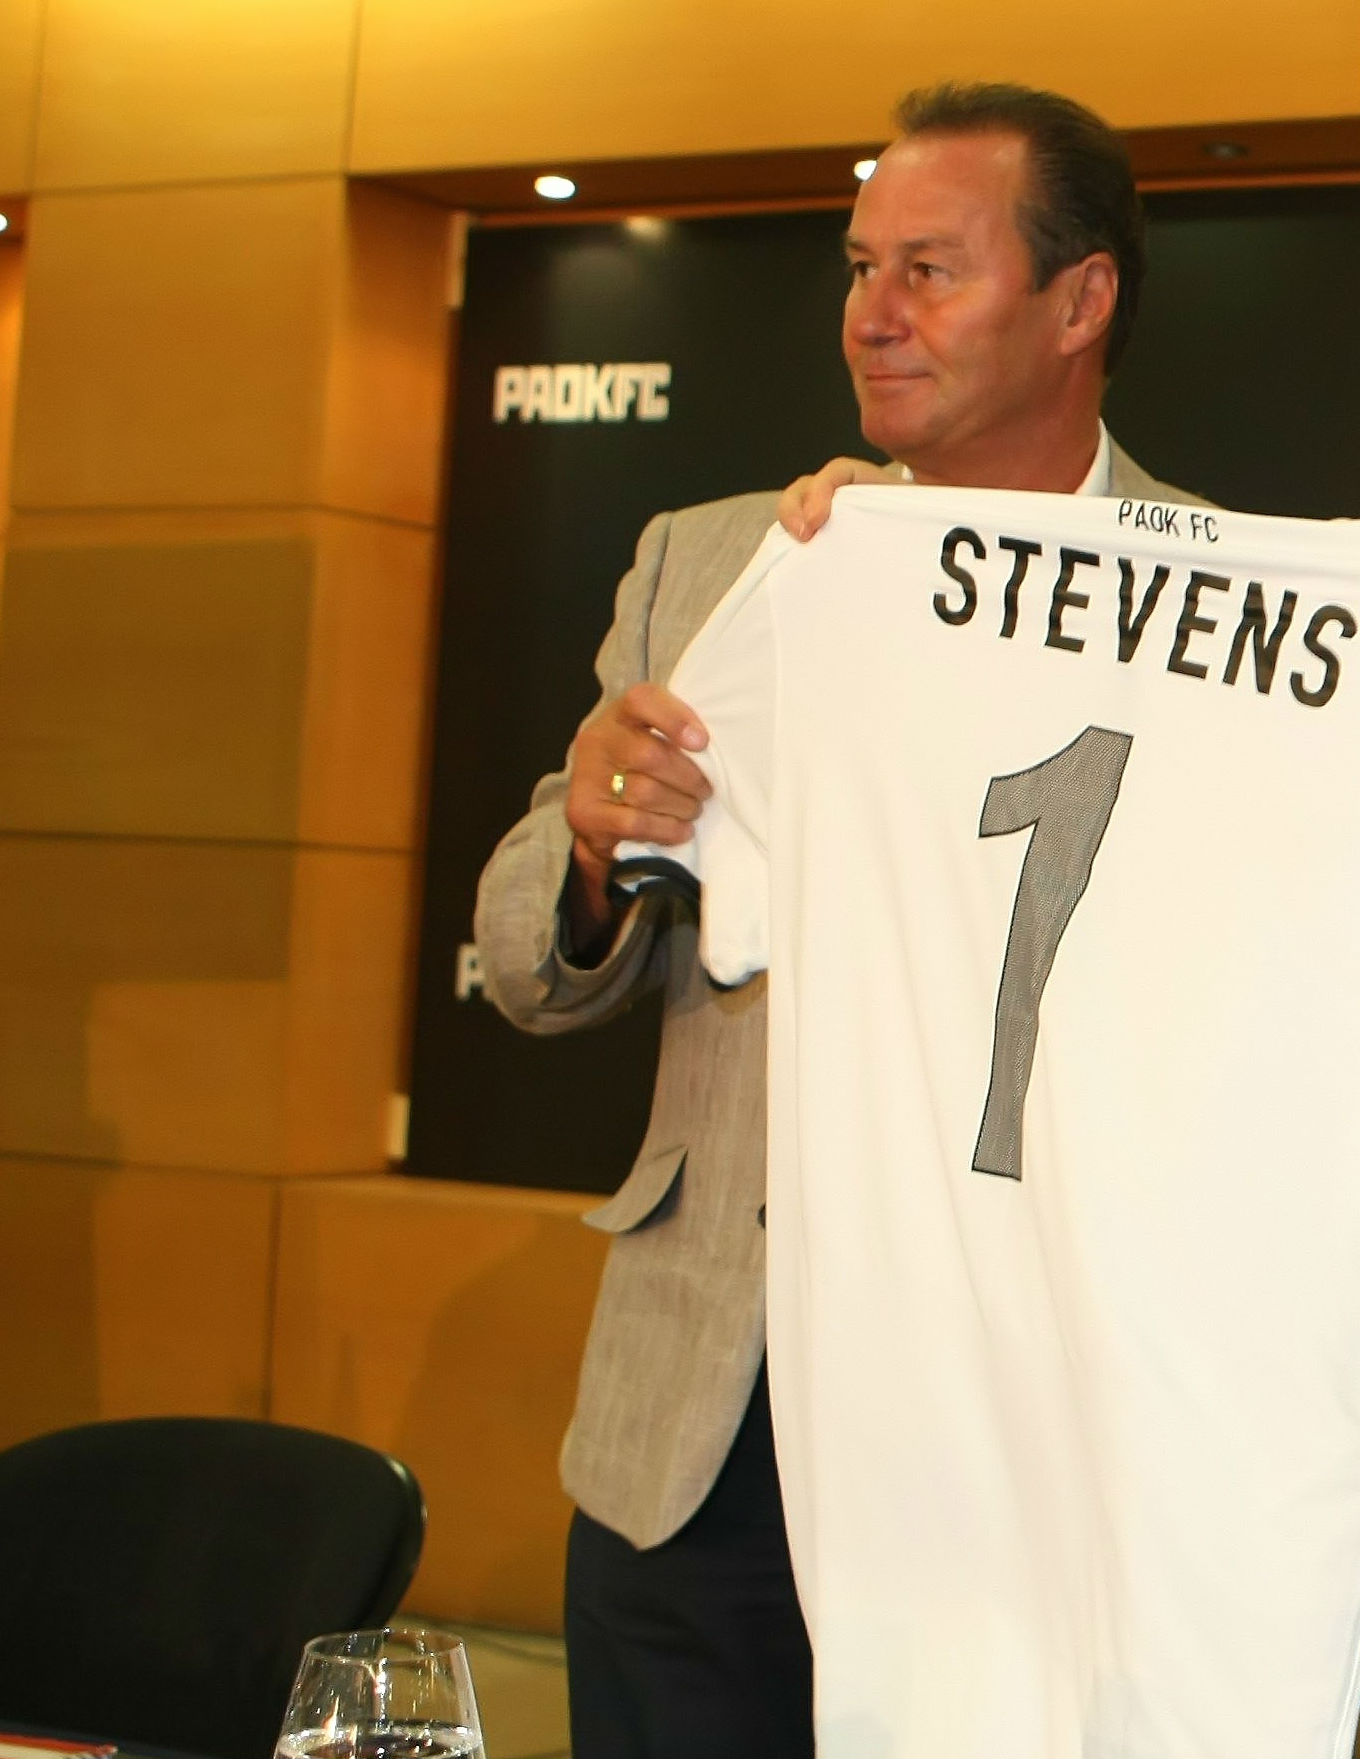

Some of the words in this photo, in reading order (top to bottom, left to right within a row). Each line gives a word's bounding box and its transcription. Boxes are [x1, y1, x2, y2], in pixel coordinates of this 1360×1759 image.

[493, 363, 671, 424] PAOKFC
[1118, 499, 1180, 537] PAOK
[1191, 513, 1219, 543] FC
[933, 526, 1357, 708] STEVENS
[971, 724, 1134, 1182] 1
